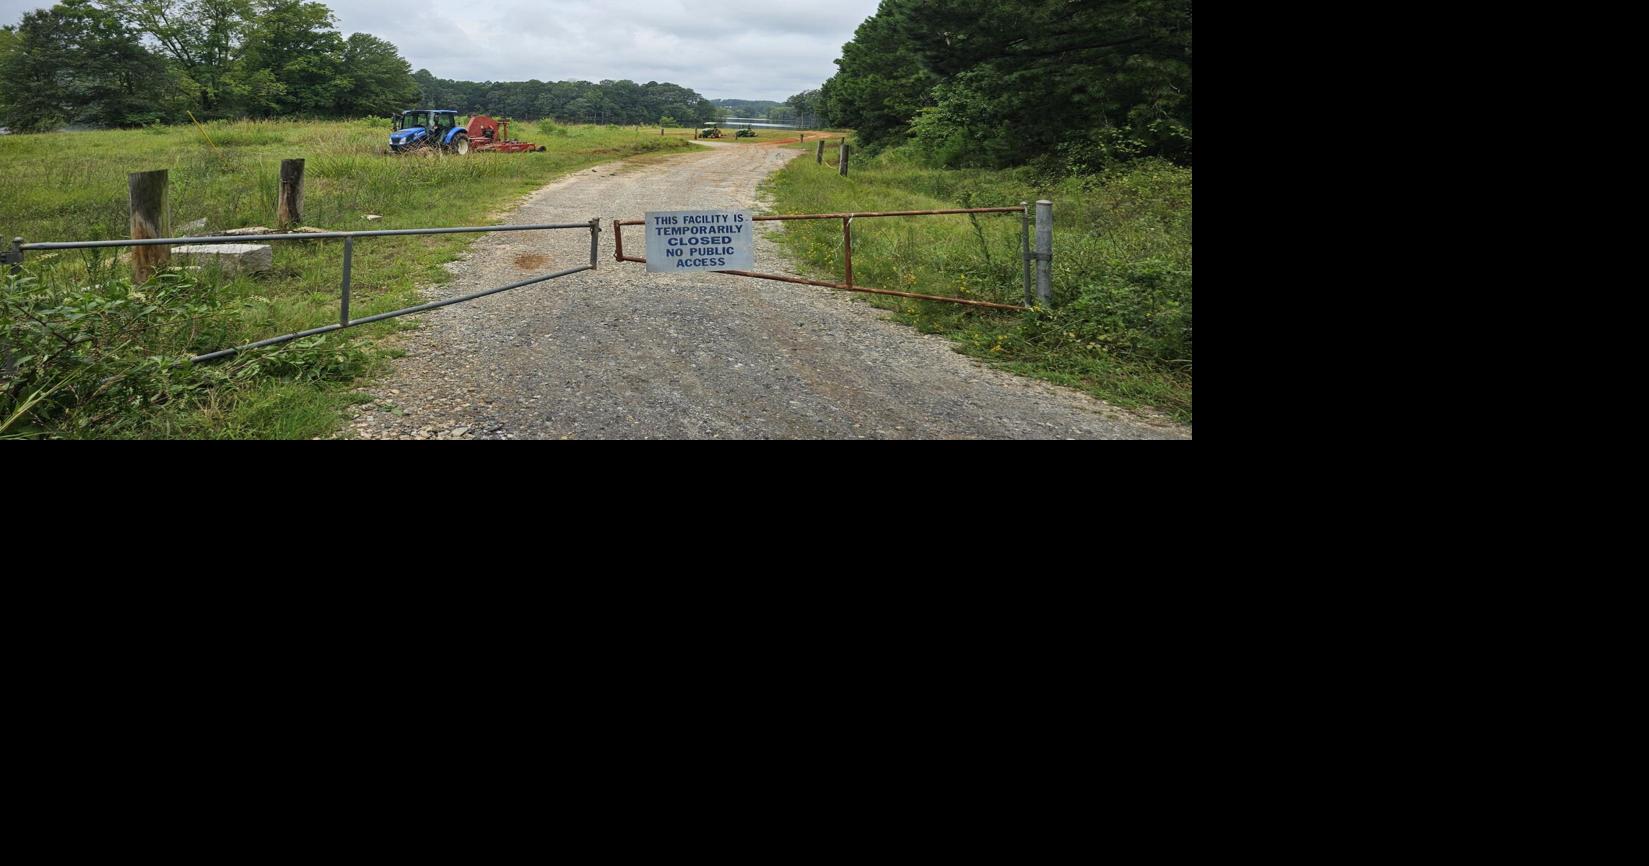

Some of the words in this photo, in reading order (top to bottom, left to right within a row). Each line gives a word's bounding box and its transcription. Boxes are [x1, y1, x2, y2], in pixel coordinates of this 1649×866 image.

[654, 216, 678, 225] THIS
[683, 214, 728, 224] FACILITY
[734, 214, 744, 223] IS
[656, 225, 743, 236] TEMPORARILY
[668, 236, 732, 246] CLOSED
[666, 248, 683, 257] NO
[690, 247, 734, 256] PUBLIC
[676, 258, 726, 267] ACCESS
